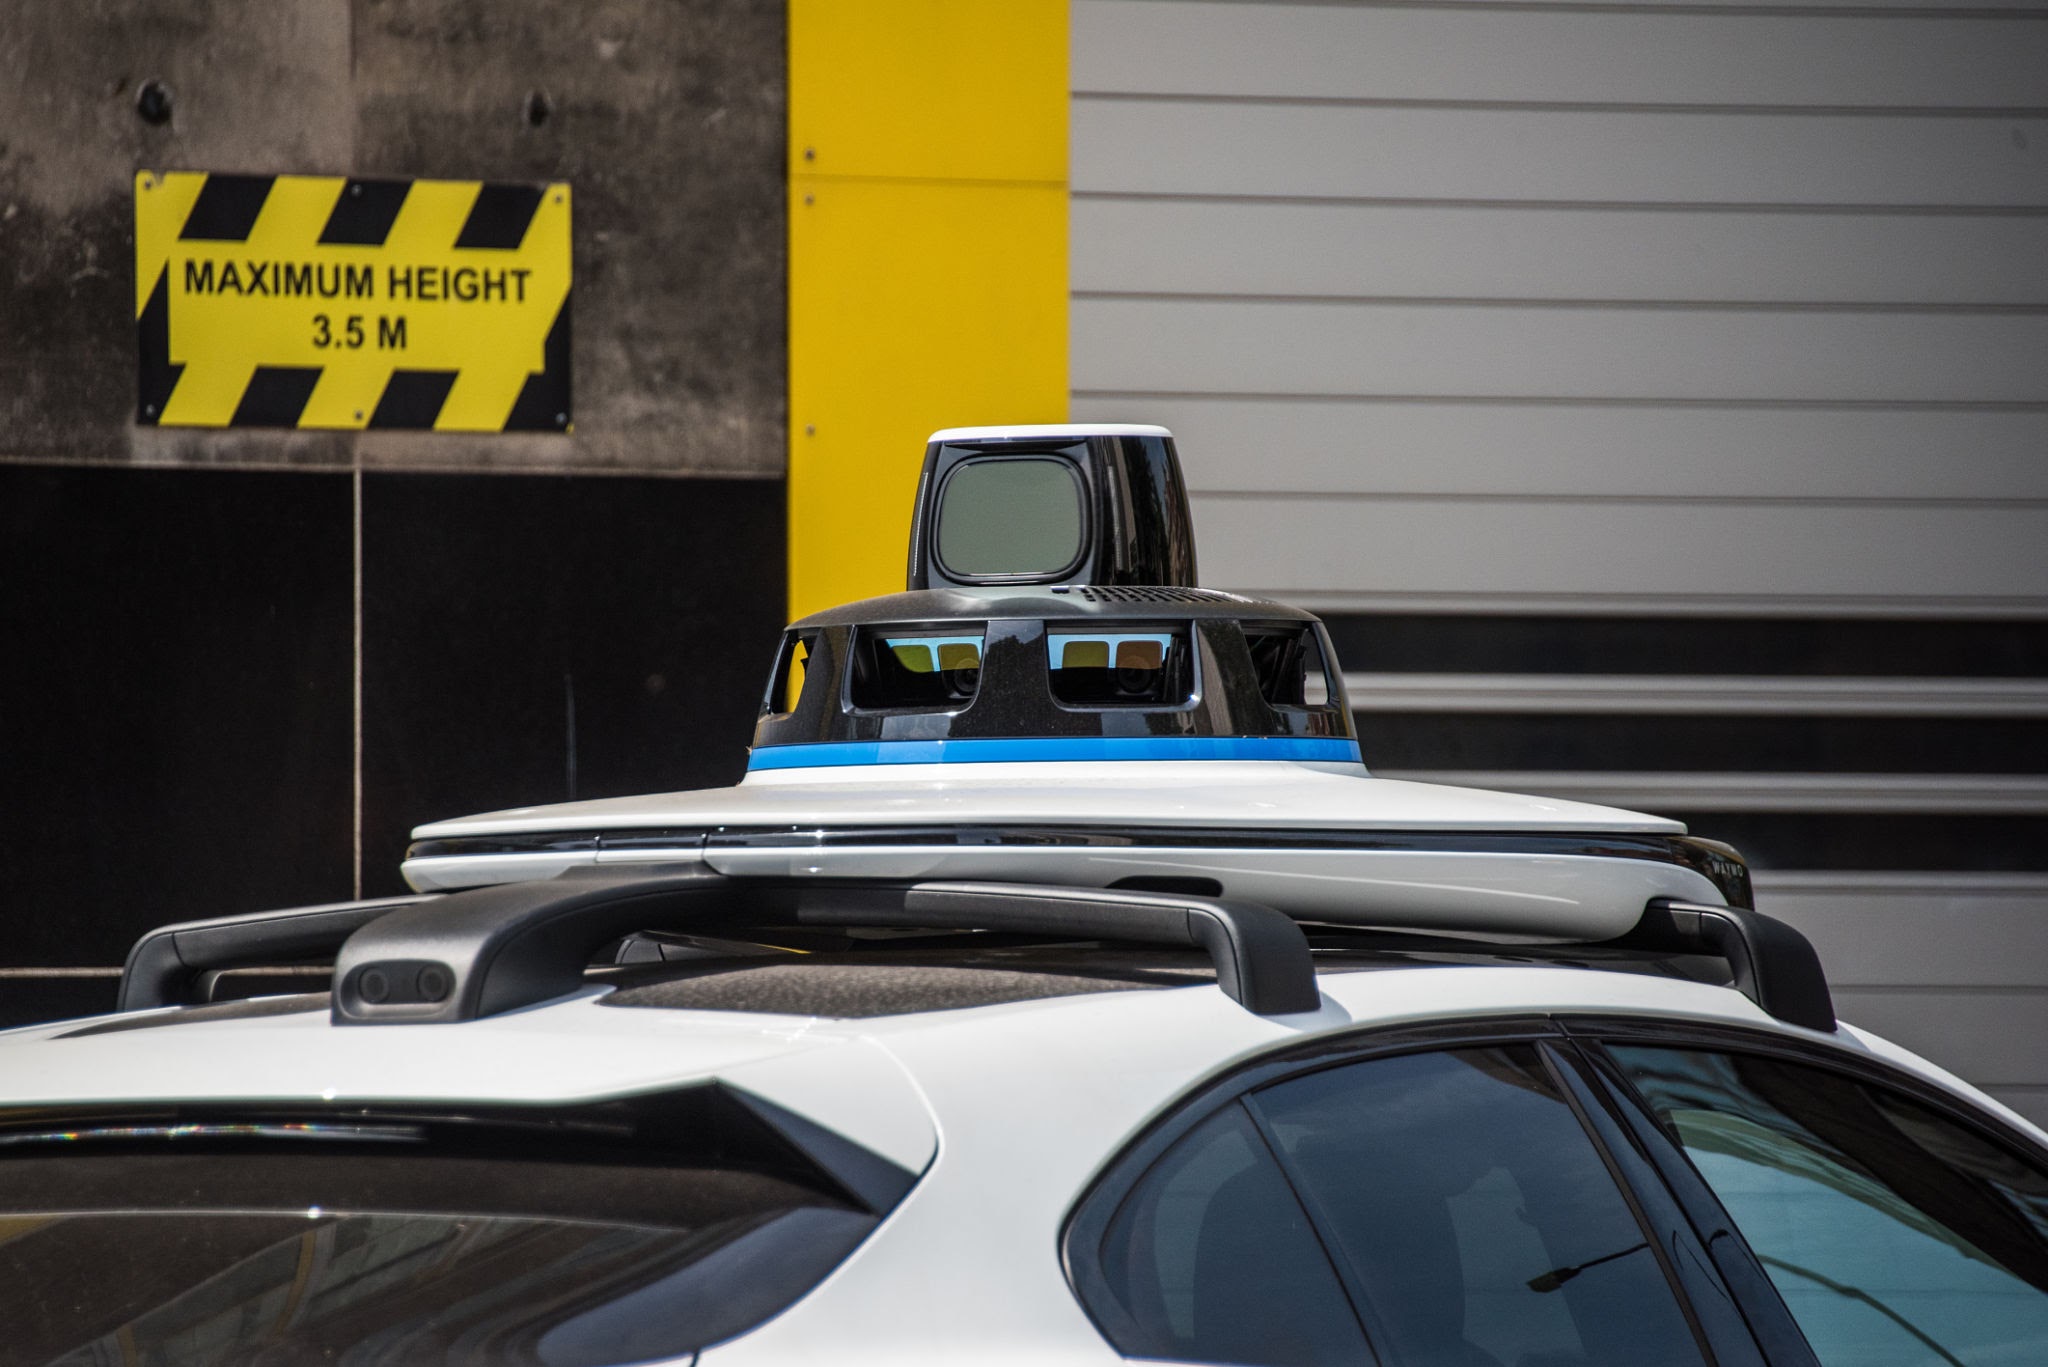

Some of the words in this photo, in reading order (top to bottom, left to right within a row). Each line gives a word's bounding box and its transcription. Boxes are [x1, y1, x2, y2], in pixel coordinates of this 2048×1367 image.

[184, 259, 374, 299] MAXIMUM
[388, 266, 532, 303] HEIGHT
[313, 313, 365, 350] 3.5
[378, 316, 407, 350] M
